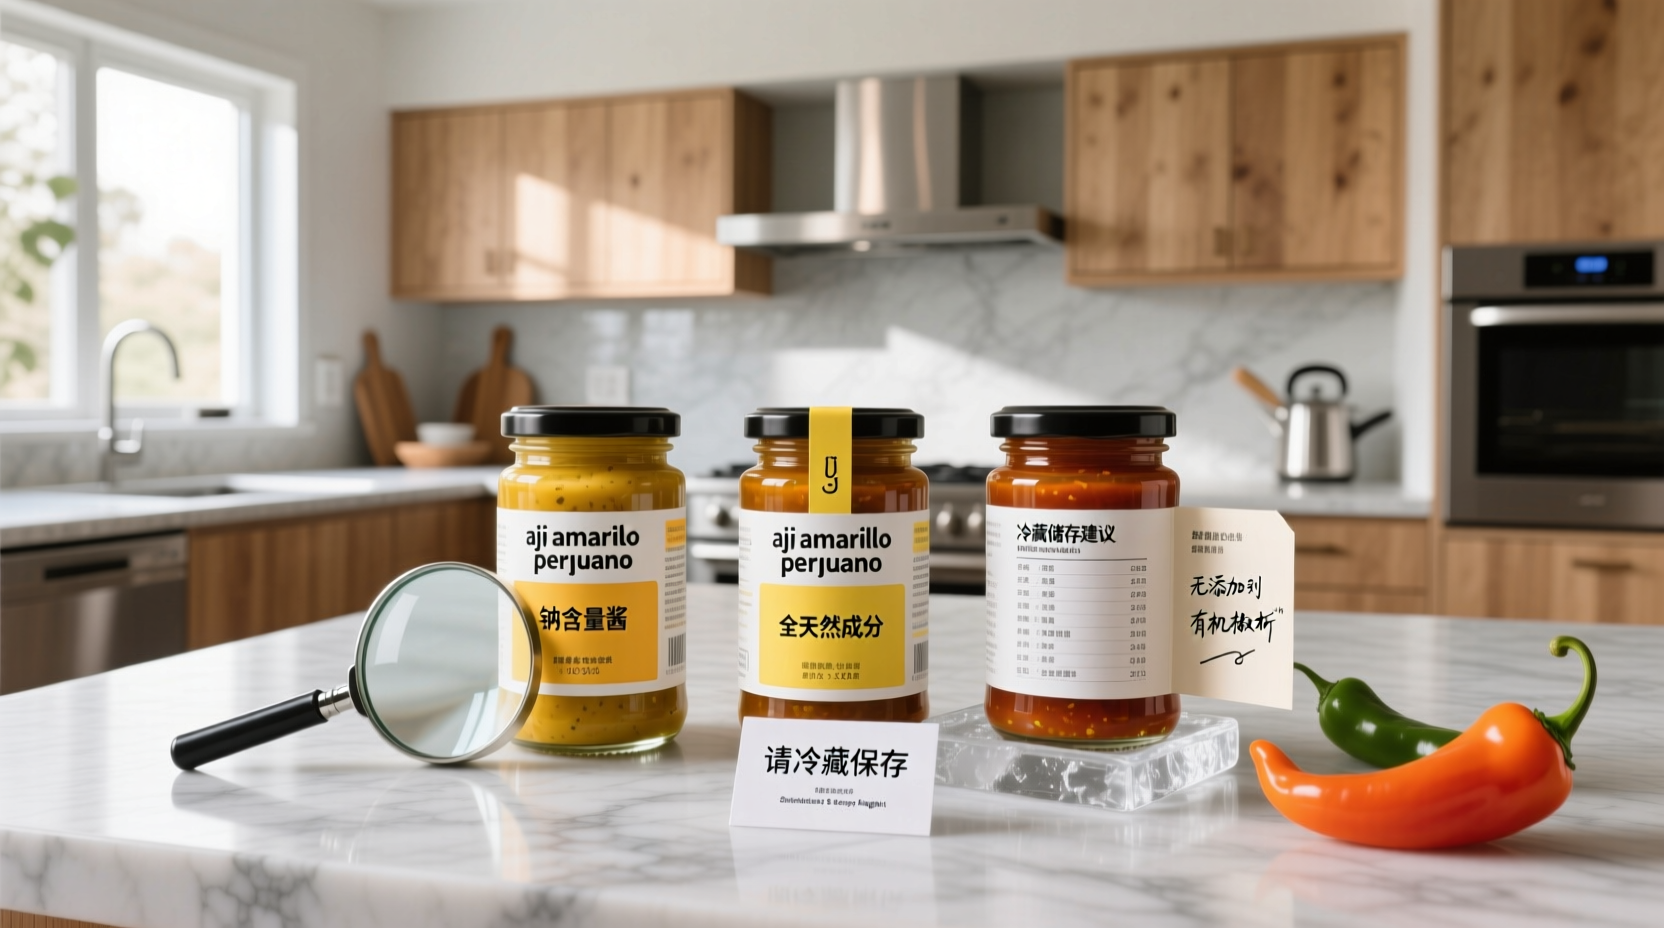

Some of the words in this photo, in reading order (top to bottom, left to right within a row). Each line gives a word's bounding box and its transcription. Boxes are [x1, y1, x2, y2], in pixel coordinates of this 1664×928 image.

[526, 525, 547, 551] aji
[552, 525, 640, 547] amarilo
[772, 527, 796, 553] aji
[800, 526, 892, 549] amarillo
[1016, 522, 1117, 544] 冷藏储存建议
[534, 554, 633, 576] perjuano
[781, 556, 882, 578] perjuano
[539, 605, 628, 632] 钠含量酱
[779, 614, 884, 639] 全天然成分
[764, 745, 909, 778] 请冷藏保存
